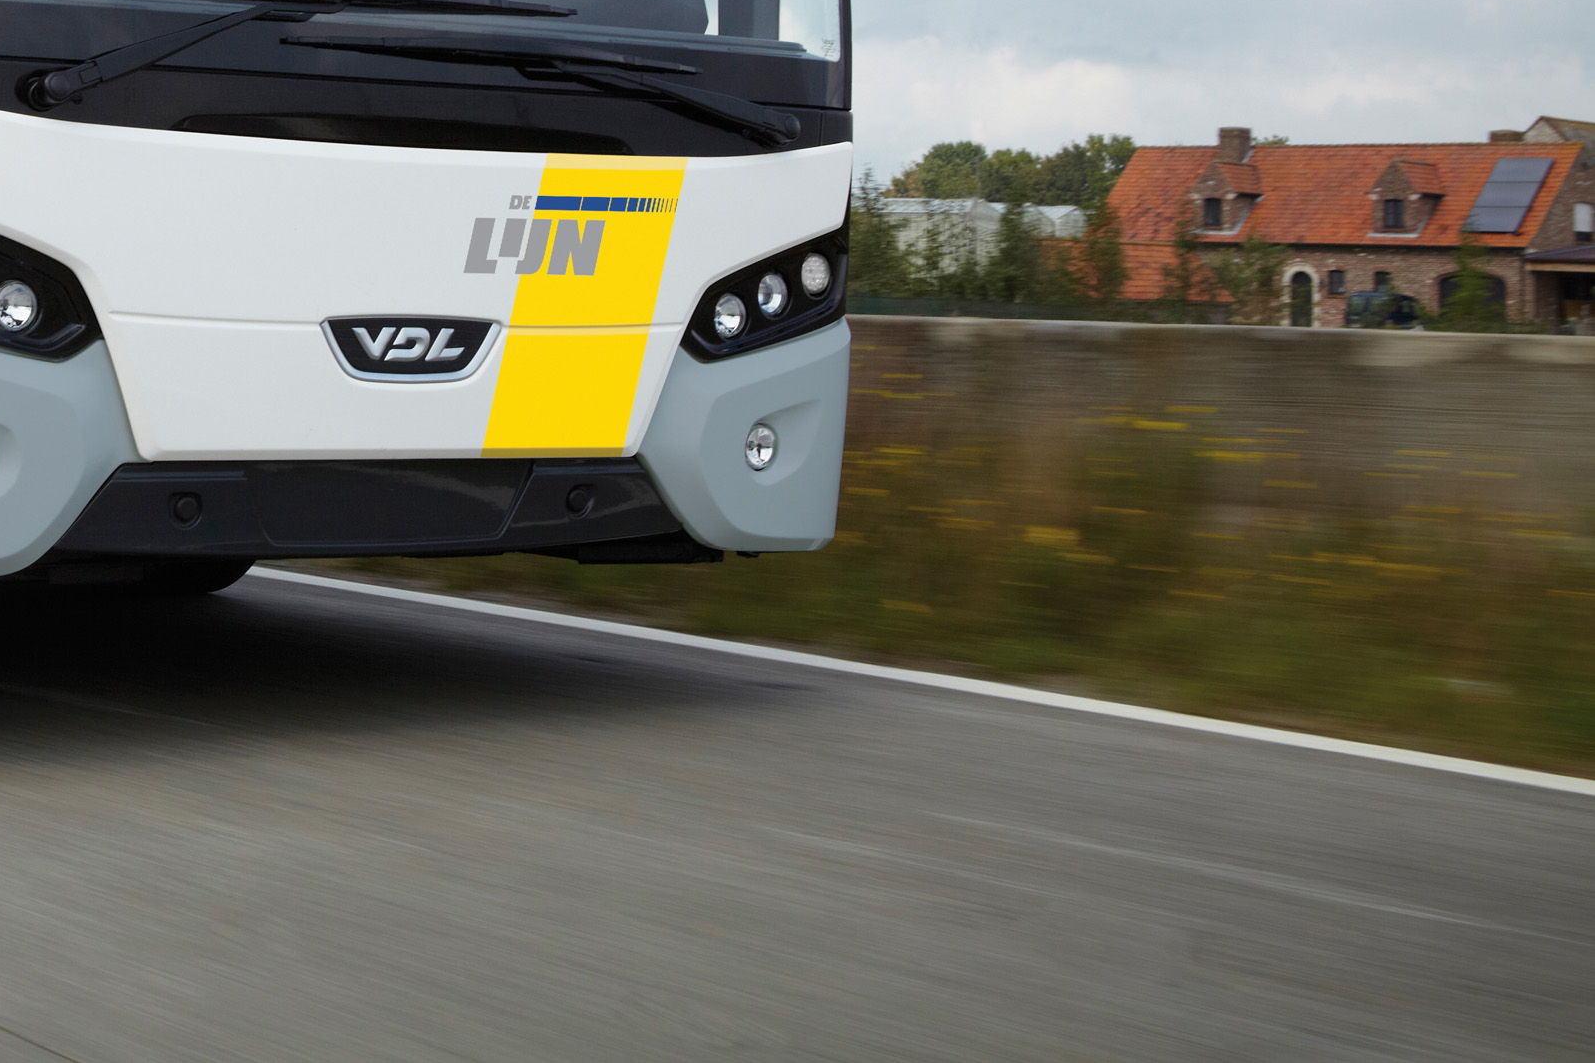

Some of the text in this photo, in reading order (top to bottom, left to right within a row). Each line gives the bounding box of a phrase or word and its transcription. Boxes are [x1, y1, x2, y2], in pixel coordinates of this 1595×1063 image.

[509, 195, 532, 210] DE
[463, 217, 606, 276] LIJN
[351, 326, 465, 362] VDL
